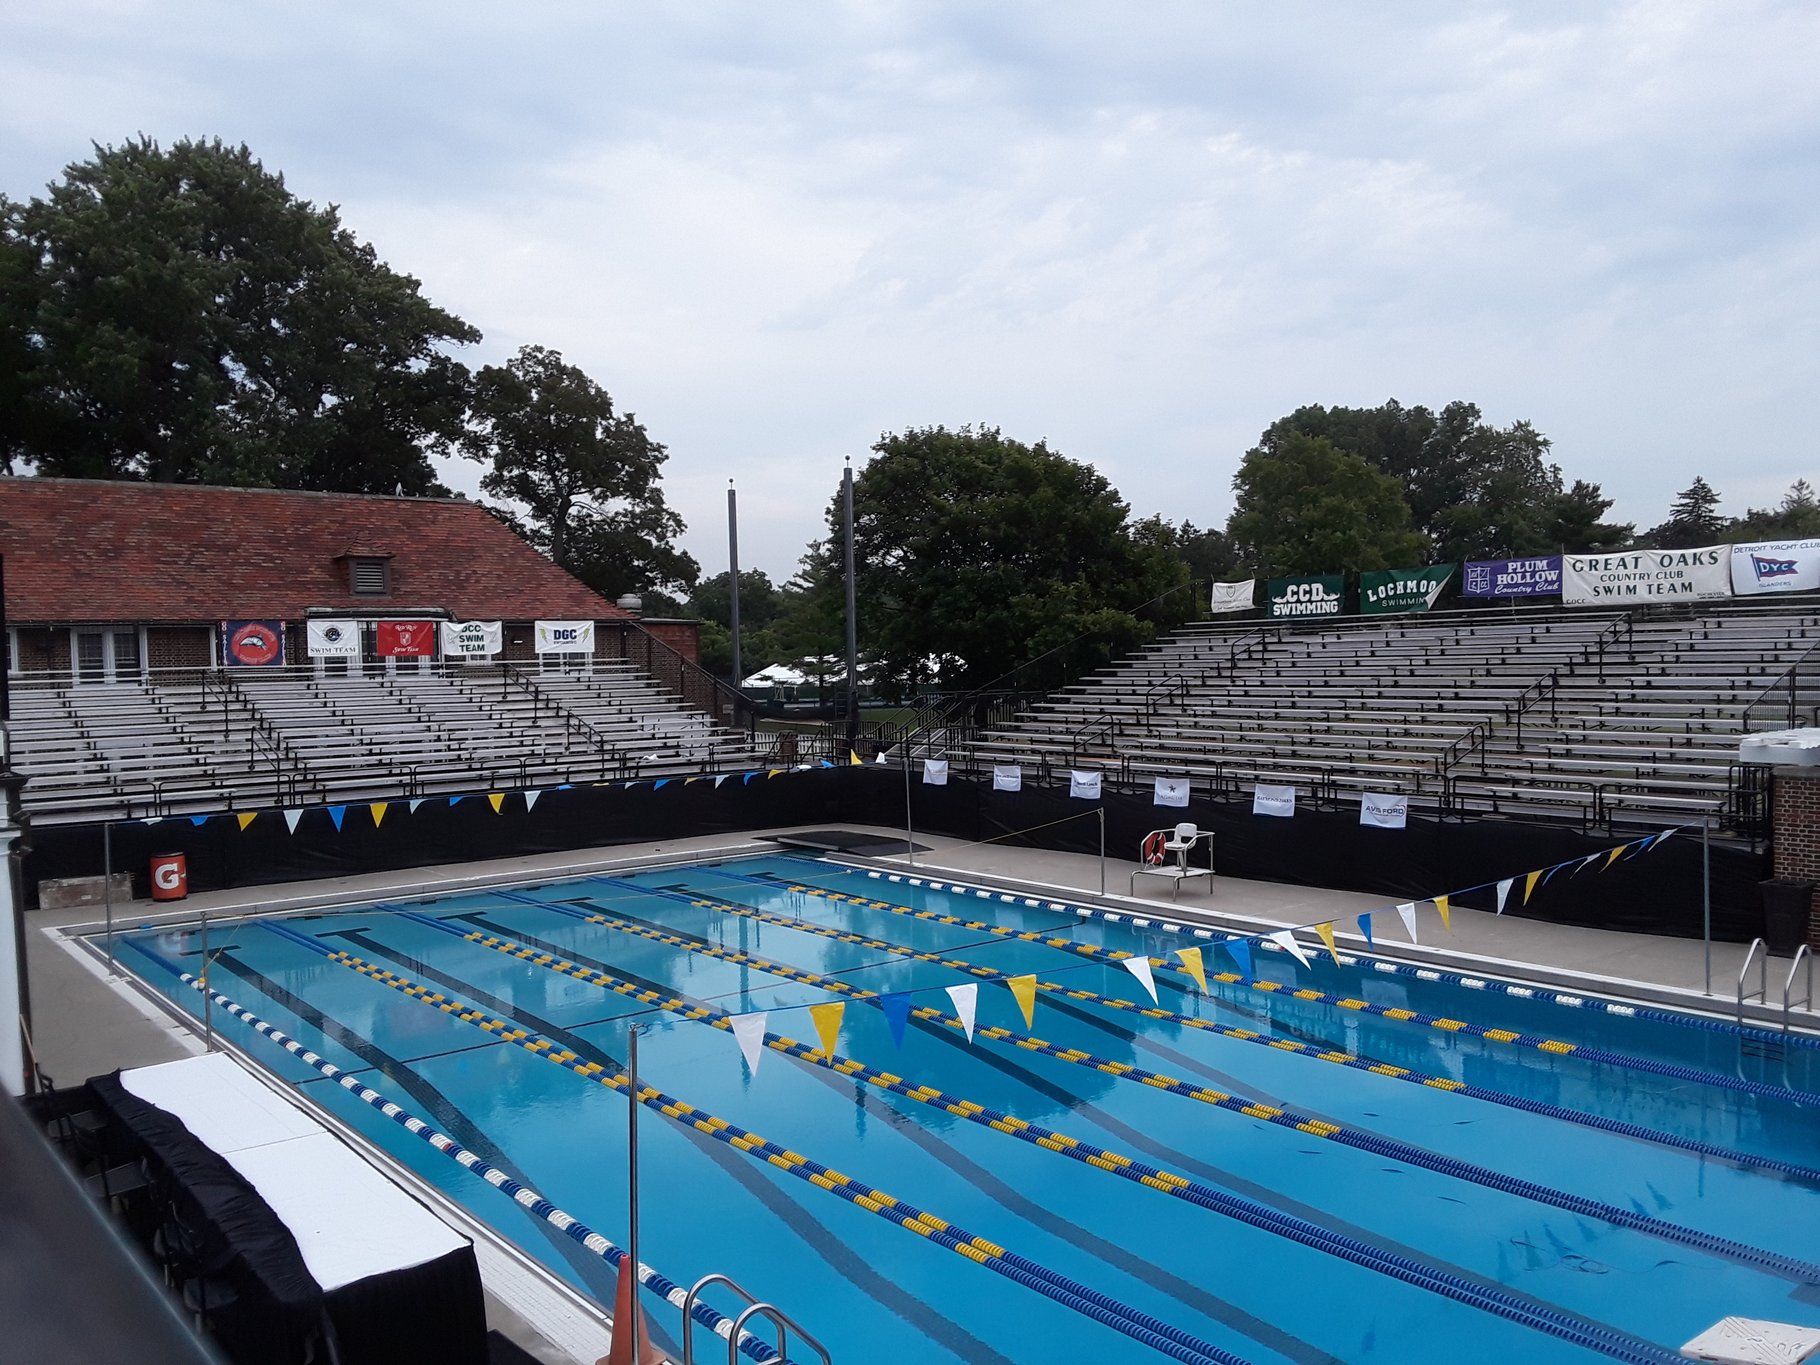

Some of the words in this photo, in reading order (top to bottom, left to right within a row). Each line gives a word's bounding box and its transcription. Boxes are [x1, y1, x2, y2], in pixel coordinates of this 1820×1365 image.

[1733, 545, 1768, 554] DETROIT
[1769, 543, 1798, 551] YACHT
[1507, 560, 1549, 573] PLUM
[1572, 556, 1643, 573] GREAT
[1659, 550, 1719, 568] OAKS
[1760, 562, 1789, 573] DYC
[1497, 570, 1560, 585] HOLLOW
[1600, 571, 1652, 582] COUNTRY
[1655, 570, 1684, 580] CLUB
[1287, 583, 1323, 602] CCD
[1367, 580, 1437, 602] LOCHMOO
[1494, 584, 1532, 594] Country
[1535, 581, 1560, 592] Club
[1593, 584, 1637, 597] SWIM
[1646, 582, 1693, 595] TEAM
[1273, 601, 1339, 616] SWIMMING
[1382, 597, 1426, 607] SWIMMIN
[459, 634, 485, 643] SWIM
[553, 629, 578, 640] DGC
[459, 644, 486, 653] TEAM
[155, 863, 179, 890] G
